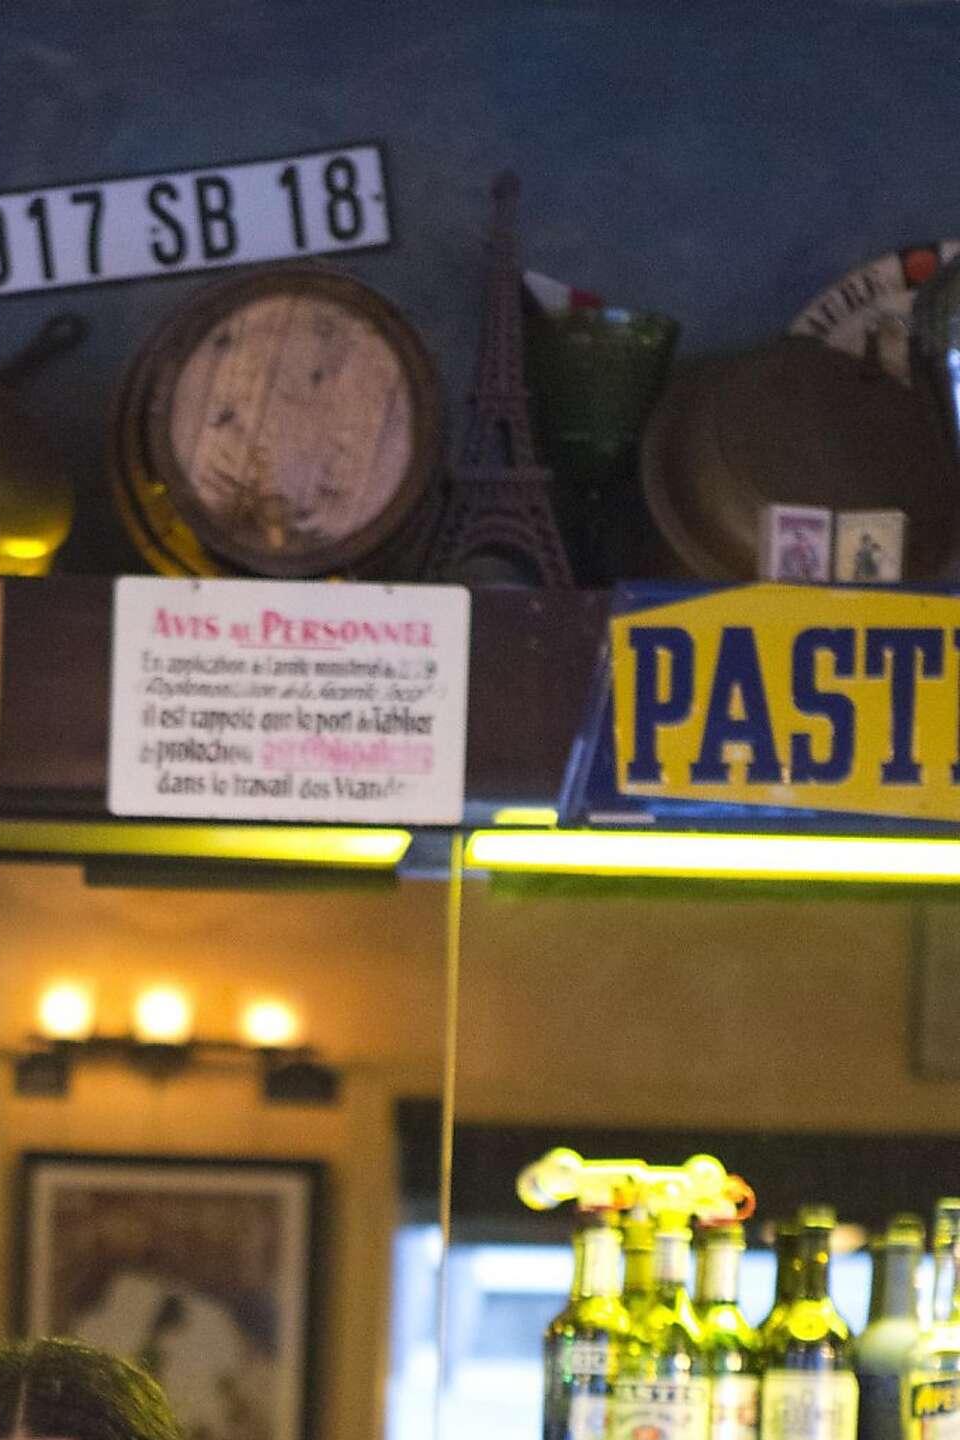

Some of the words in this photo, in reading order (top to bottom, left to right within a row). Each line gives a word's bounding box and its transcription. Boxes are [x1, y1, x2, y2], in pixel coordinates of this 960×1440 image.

[146, 174, 238, 267] SB
[278, 156, 363, 251] 18
[626, 626, 960, 785] PAST
